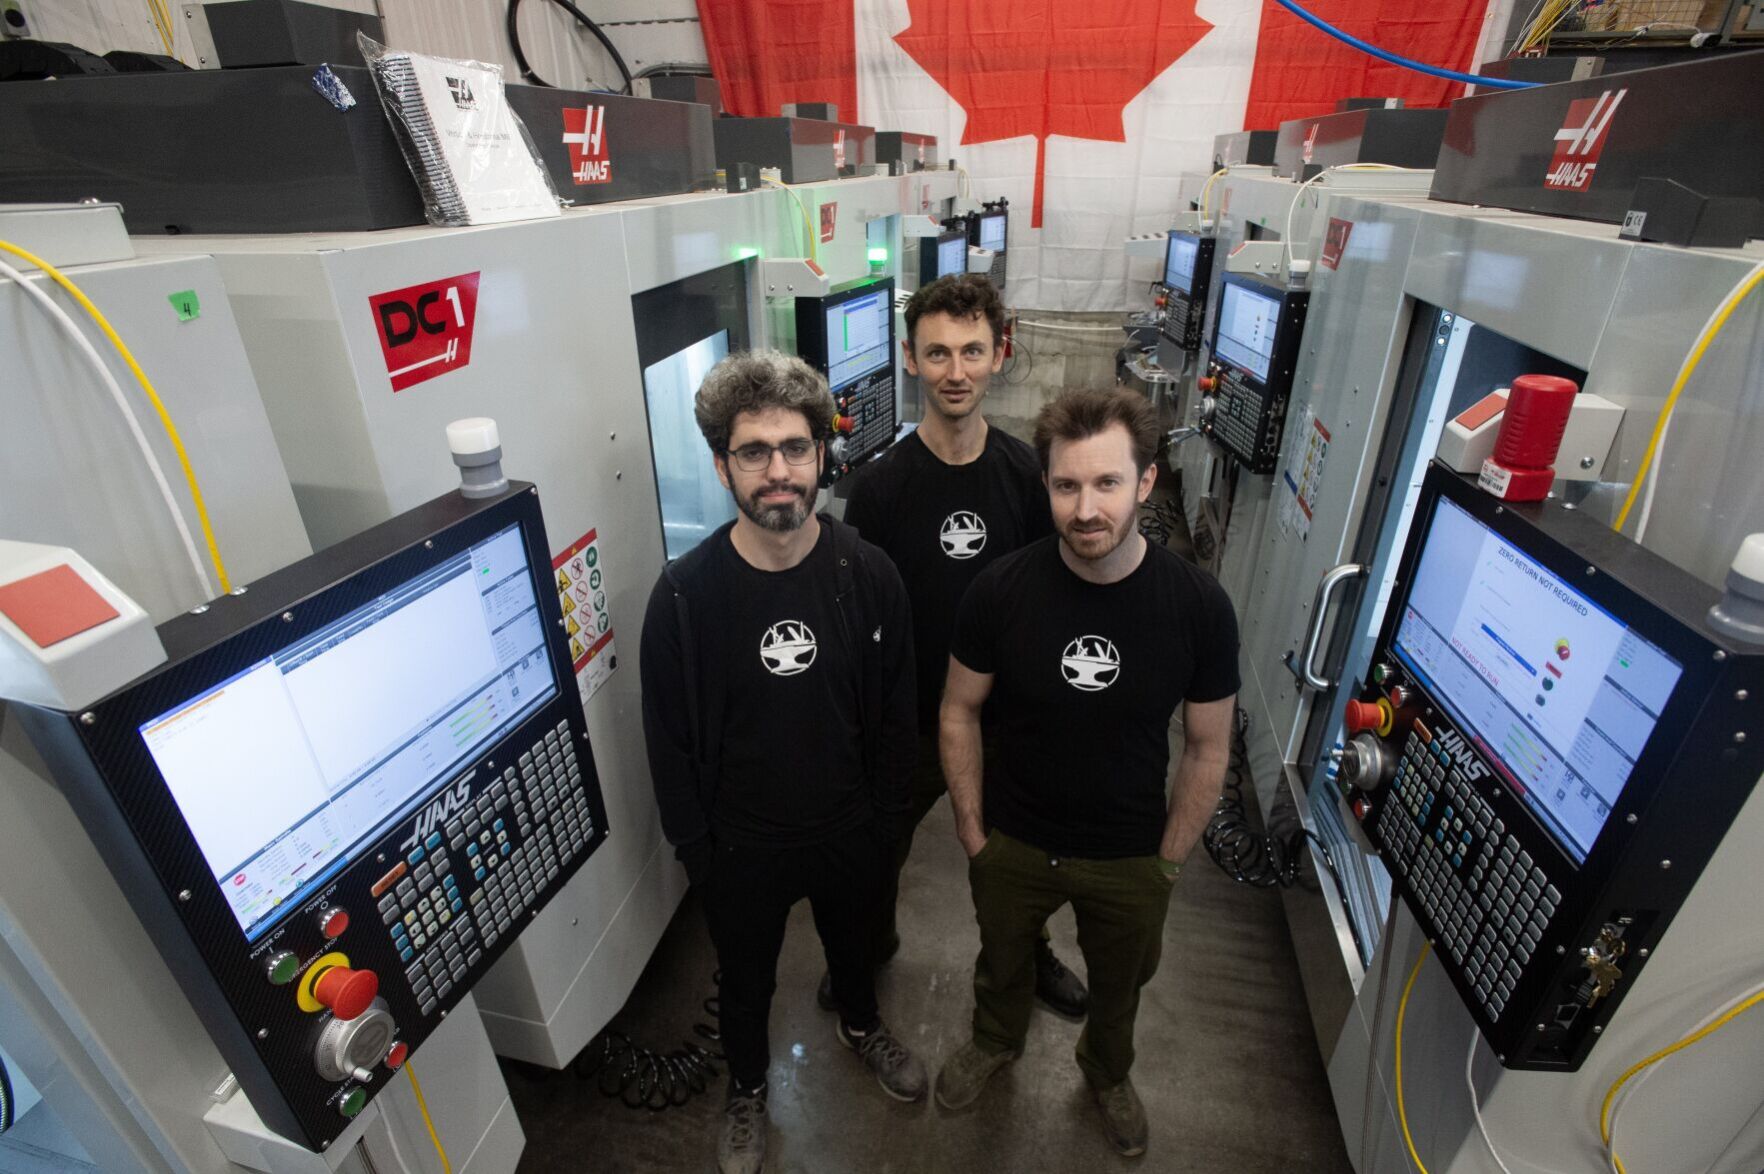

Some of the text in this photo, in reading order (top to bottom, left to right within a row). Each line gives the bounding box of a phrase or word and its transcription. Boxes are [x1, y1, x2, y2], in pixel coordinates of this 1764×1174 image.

[573, 161, 610, 181] HAAS
[1546, 162, 1596, 187] HAAS
[379, 286, 465, 349] DC1
[1498, 547, 1588, 616] ZERO RETURN NOT REQUIRED
[1451, 637, 1462, 649] NOT
[1462, 645, 1479, 667] READY
[1478, 661, 1487, 674] TO
[1486, 671, 1500, 687] RUN
[400, 769, 477, 851] HAAS
[305, 885, 337, 914] POWER OFF
[250, 929, 285, 960] POWER ON
[326, 1088, 346, 1106] CYCLE
